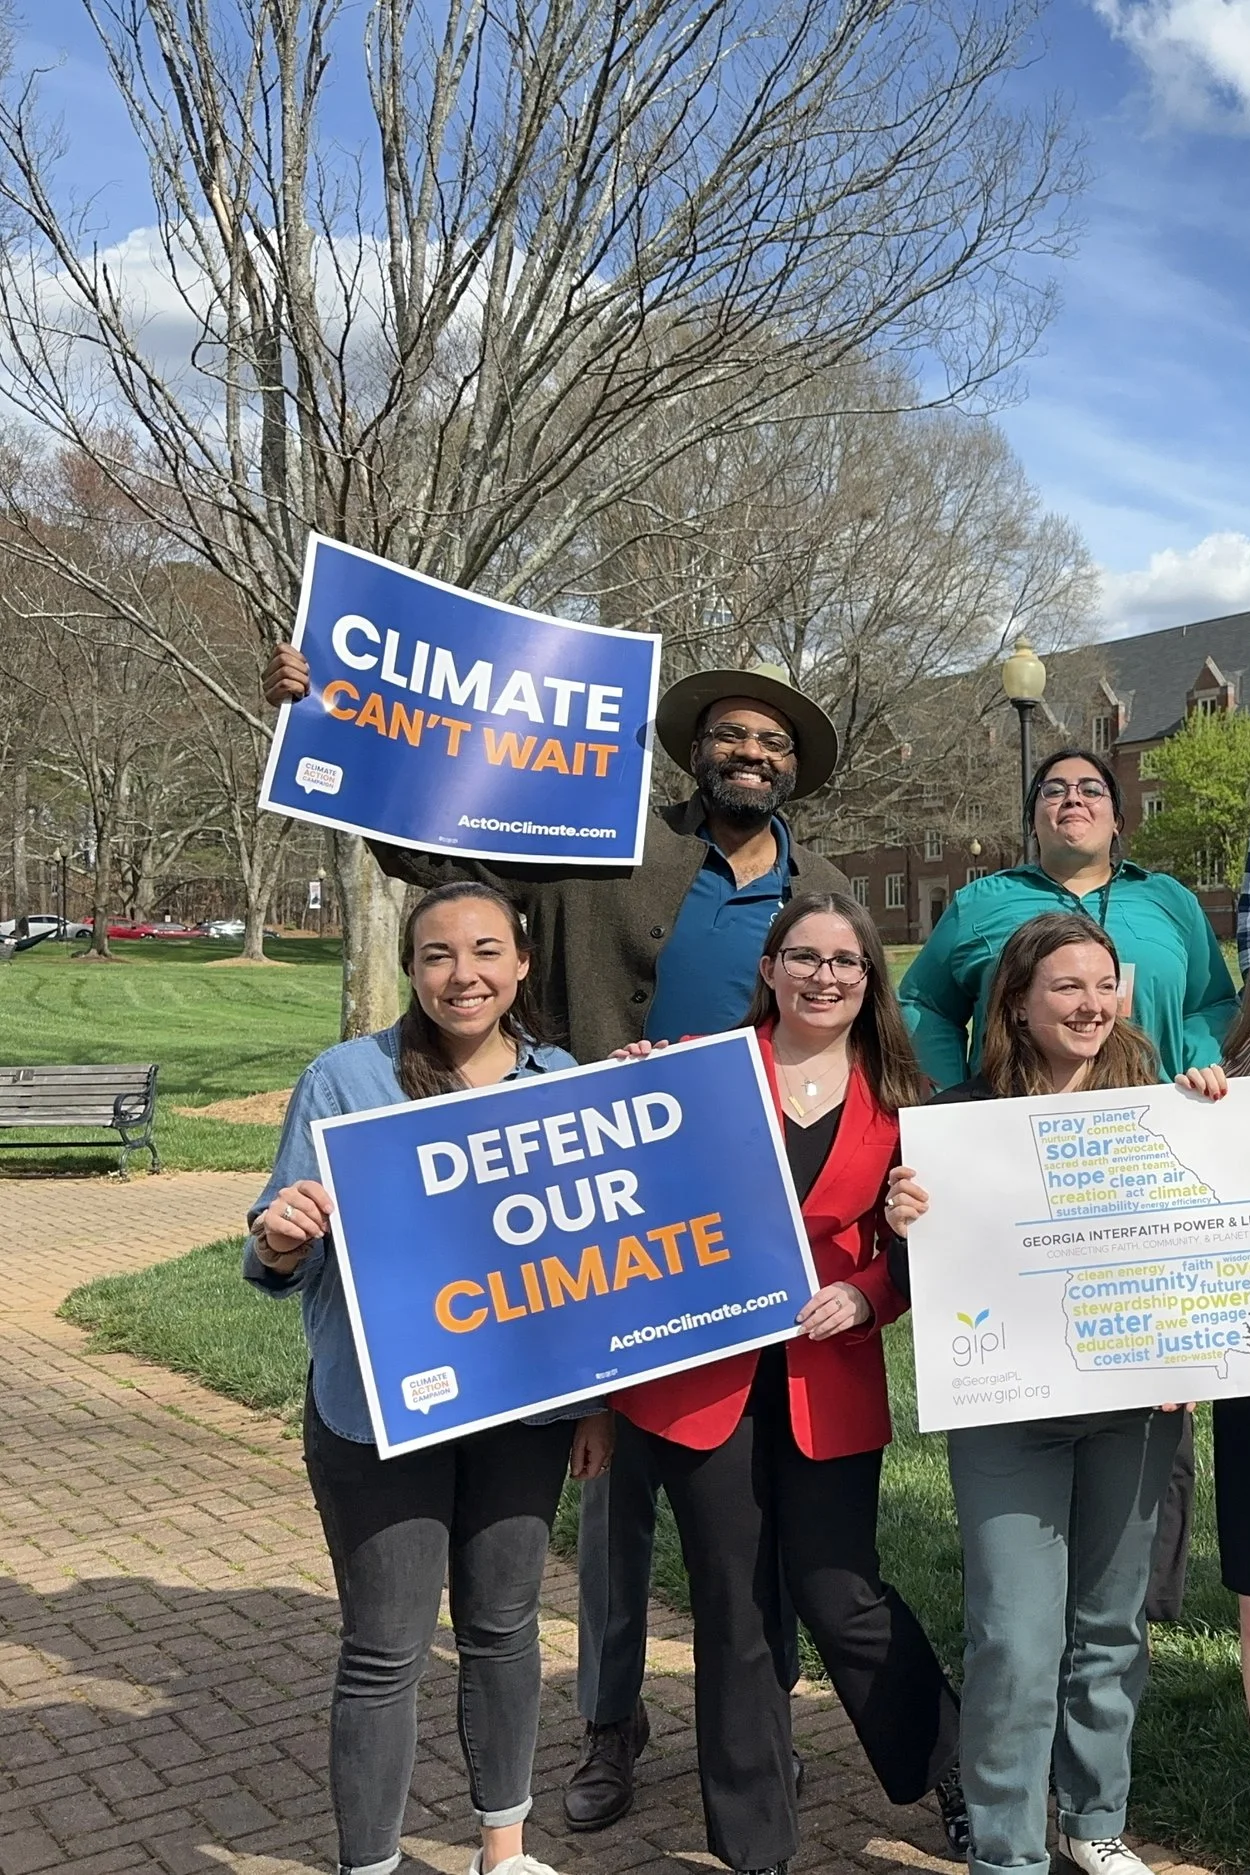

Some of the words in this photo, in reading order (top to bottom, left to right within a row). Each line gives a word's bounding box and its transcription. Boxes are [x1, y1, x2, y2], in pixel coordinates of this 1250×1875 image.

[332, 615, 623, 732] CLIMATE
[322, 680, 471, 757] CAN'T
[483, 727, 618, 777] WAIT
[304, 769, 335, 783] ACTION
[306, 763, 336, 776] CLIMATE
[302, 776, 334, 788] CAMPAIGN
[458, 815, 617, 839] ActOnClimate.com
[1038, 1115, 1085, 1137] pray
[1093, 1110, 1136, 1126] planet
[1041, 1134, 1077, 1144] nurture
[1087, 1123, 1137, 1136] connect
[416, 1090, 683, 1196] DEFEND
[1046, 1136, 1113, 1161] solar
[1113, 1141, 1165, 1155] advocate
[1116, 1134, 1150, 1145] water
[1044, 1159, 1079, 1171] sacred
[1081, 1157, 1109, 1167] earth
[1112, 1151, 1169, 1164] environment
[1108, 1162, 1139, 1176] green
[1142, 1159, 1176, 1170] teams
[1048, 1168, 1105, 1190] hope
[1110, 1171, 1157, 1189] clean
[1163, 1168, 1185, 1183] air
[1050, 1187, 1117, 1206] creation
[1126, 1188, 1144, 1199] act
[1149, 1184, 1208, 1200] climate
[492, 1168, 645, 1247] OUR
[1056, 1200, 1140, 1218] sustainability
[1140, 1200, 1169, 1210] energy
[1172, 1196, 1212, 1207] efficiency
[1022, 1231, 1084, 1248] GEORGIA
[1089, 1223, 1170, 1241] INTERFAITH
[1174, 1217, 1225, 1233] POWER
[1229, 1217, 1237, 1227] &
[1047, 1242, 1109, 1259] CONNECTING
[1204, 1233, 1211, 1242] &
[1213, 1230, 1249, 1241] PLANET
[434, 1212, 731, 1334] CLIMATE
[1077, 1269, 1114, 1282] clean
[1118, 1263, 1165, 1279] energy
[1182, 1258, 1213, 1272] faith
[1068, 1271, 1199, 1300] community
[1073, 1294, 1178, 1317] stewardship
[609, 1290, 788, 1352] ActOnClimate.com
[1075, 1312, 1153, 1339] water
[1155, 1316, 1188, 1331] awe
[1191, 1307, 1247, 1326] engage
[952, 1322, 1005, 1366] gipl
[1077, 1333, 1154, 1353] education
[1156, 1328, 1241, 1358] justice
[1094, 1348, 1150, 1367] coexist
[1164, 1350, 1222, 1365] zero-waste
[410, 1372, 447, 1388] CLIMATE
[412, 1380, 449, 1397] ACTION
[413, 1388, 450, 1403] CAMPAIGN
